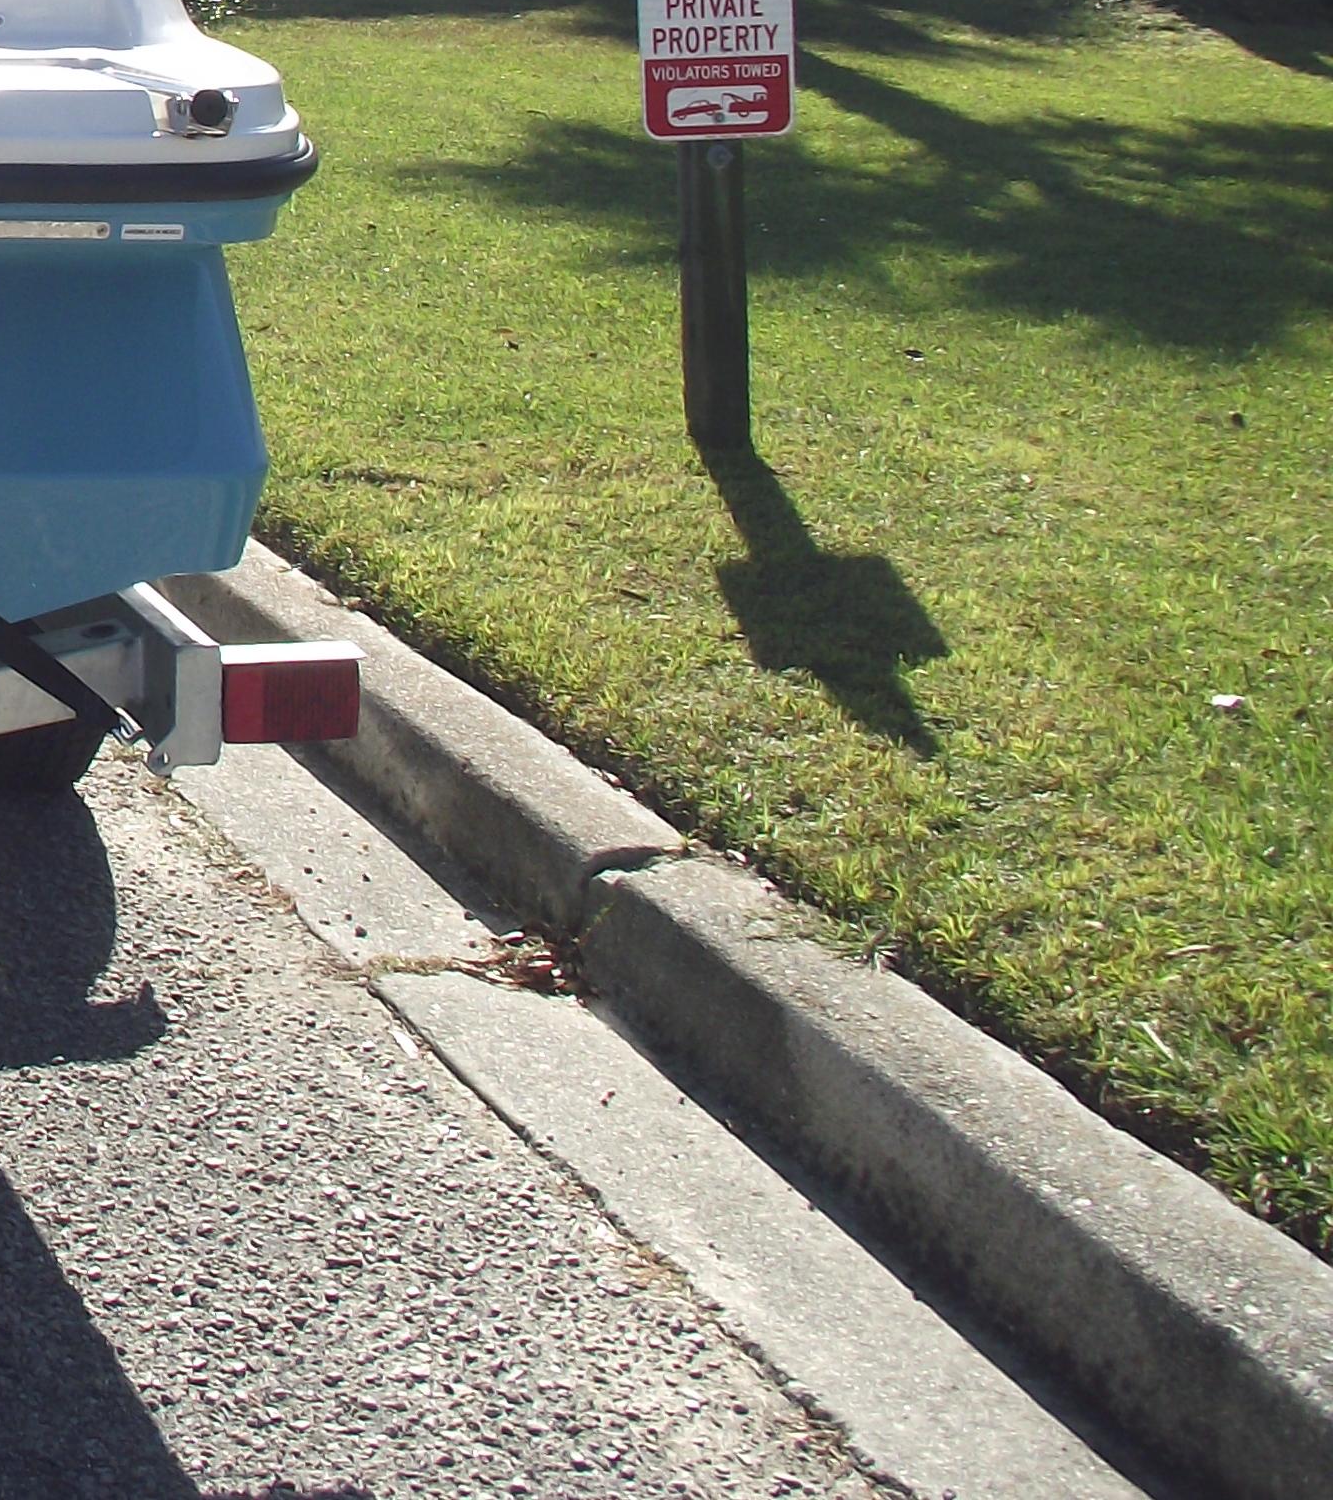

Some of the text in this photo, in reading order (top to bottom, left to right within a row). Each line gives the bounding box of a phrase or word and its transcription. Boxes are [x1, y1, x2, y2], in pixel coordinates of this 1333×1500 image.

[652, 24, 779, 54] PROPERTY
[652, 63, 781, 81] VIOLATORS TOWED
